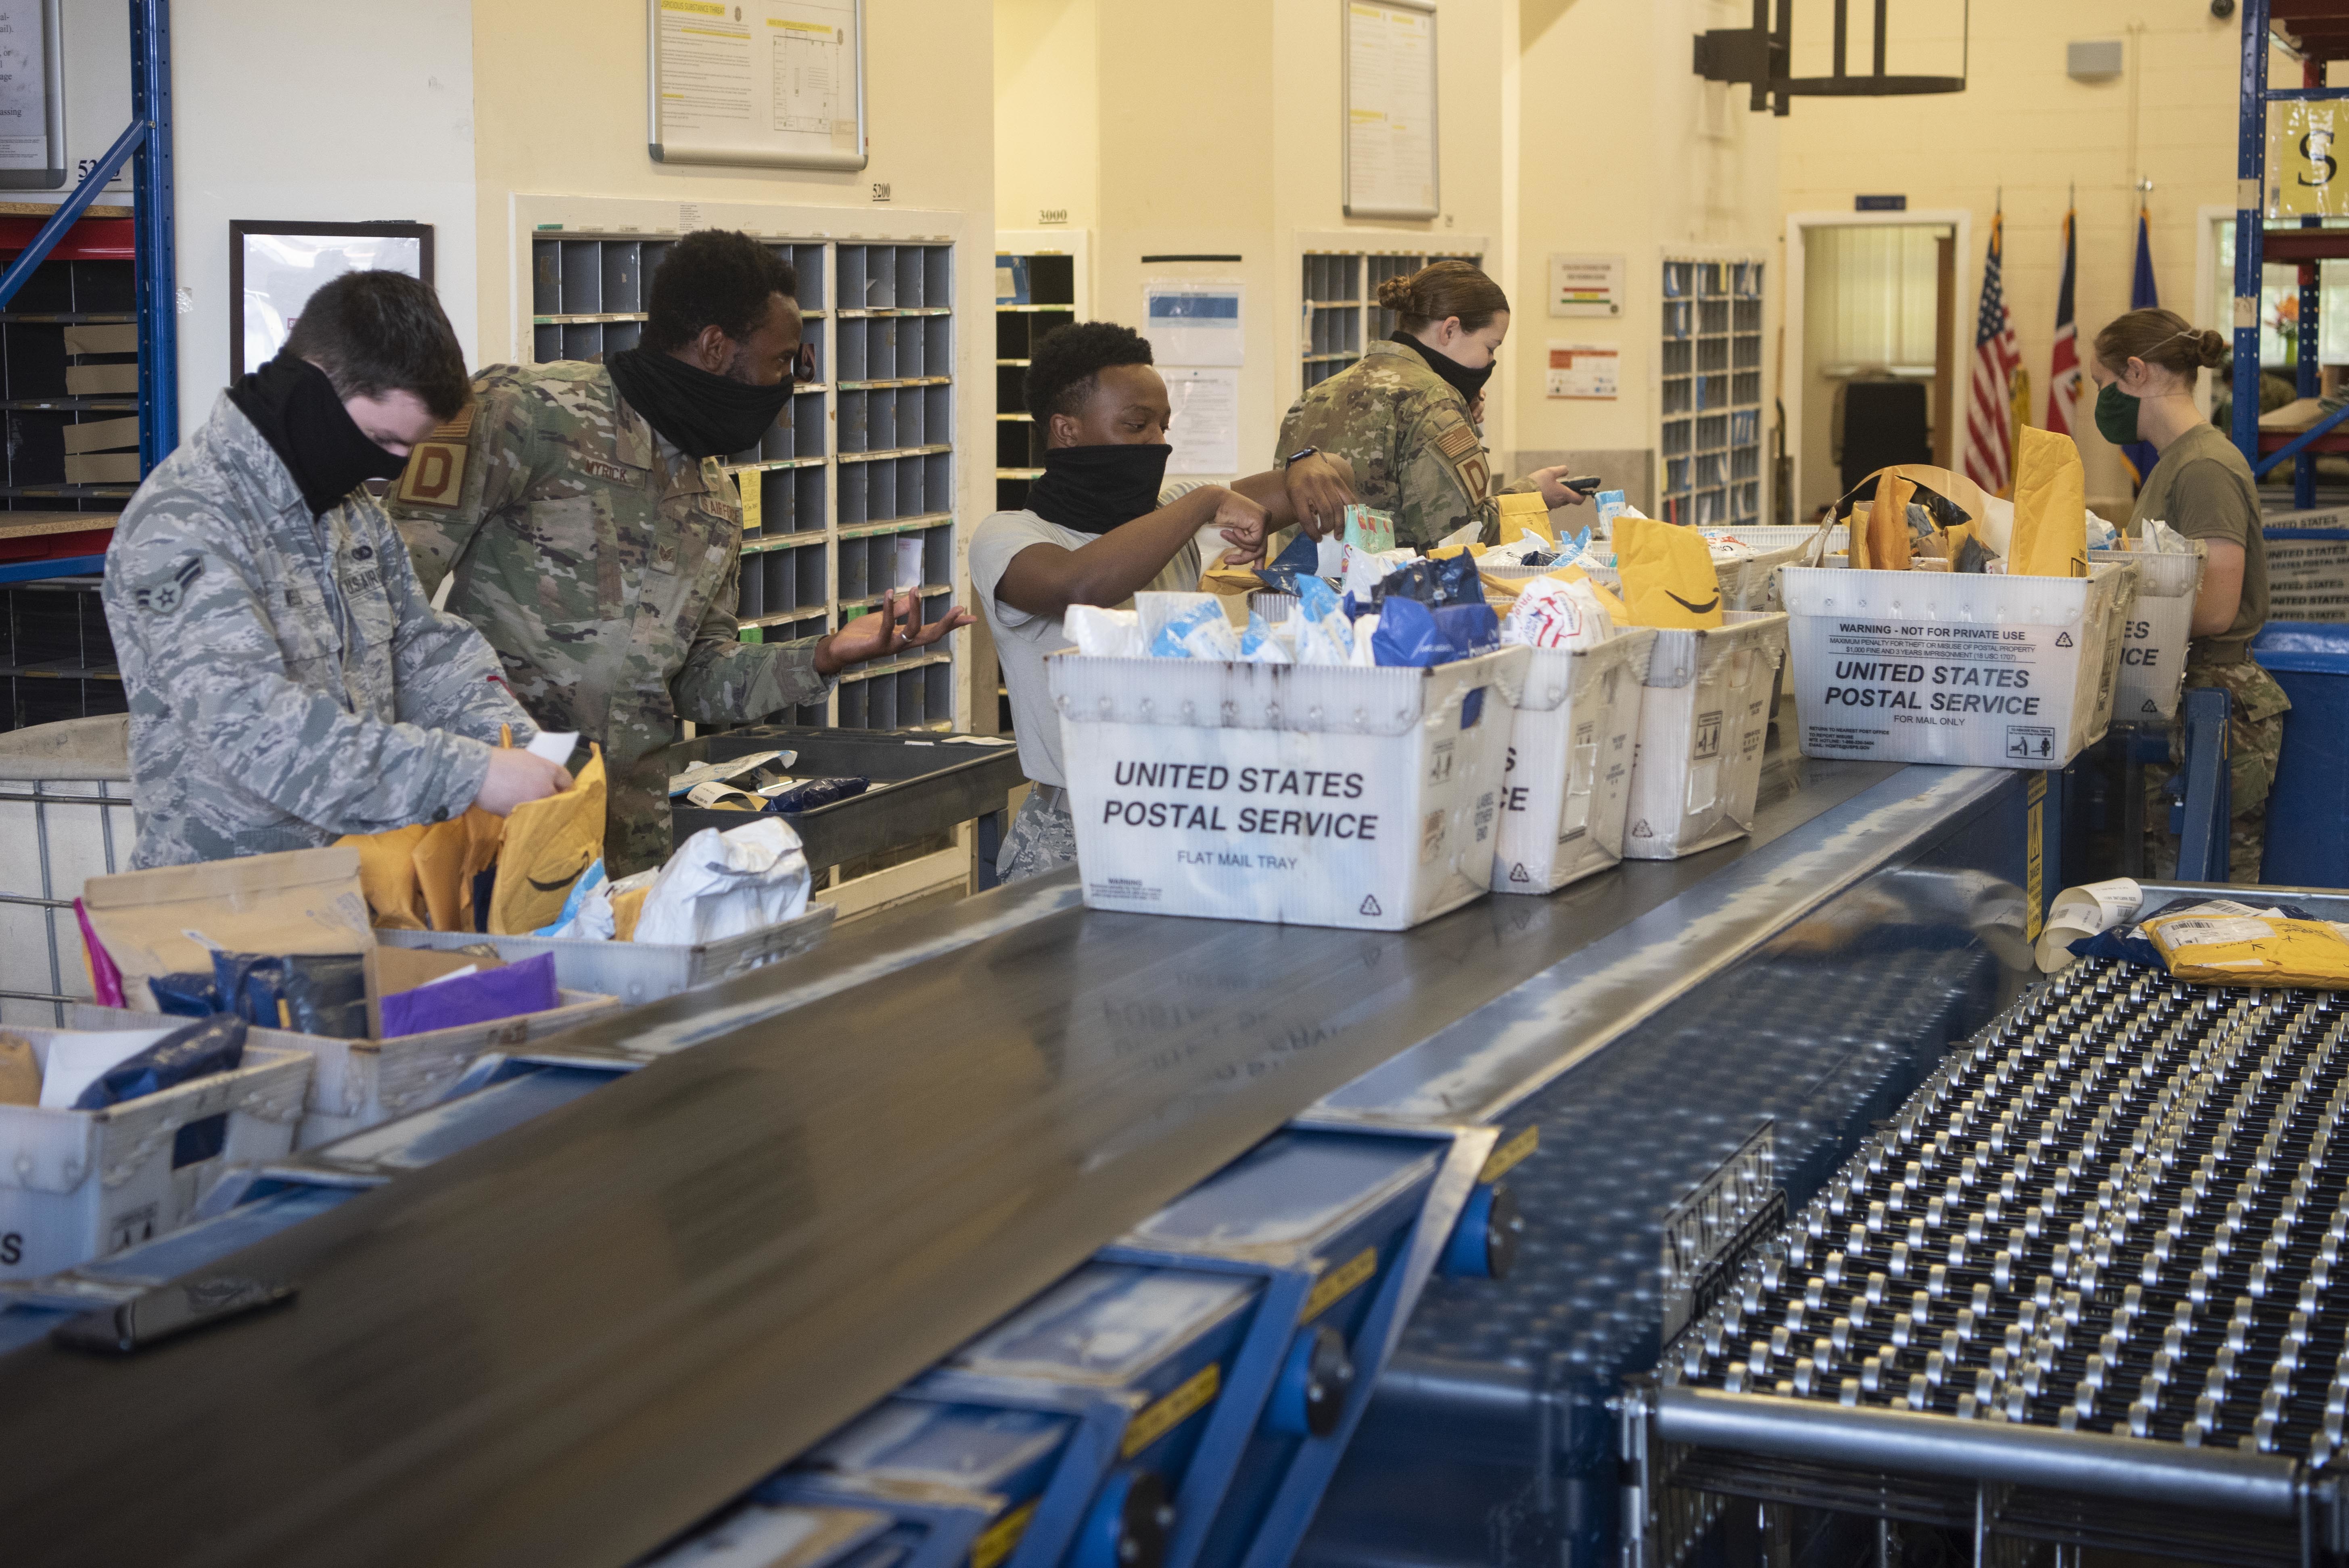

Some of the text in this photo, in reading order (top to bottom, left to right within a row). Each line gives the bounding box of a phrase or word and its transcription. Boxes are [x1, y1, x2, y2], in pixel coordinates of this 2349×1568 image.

[710, 6, 725, 14] THREAT
[0, 107, 22, 117] assing
[2297, 130, 2337, 187] S
[872, 184, 890, 199] 5200
[1039, 209, 1068, 222] 3000
[585, 459, 626, 482] MYRICK
[1840, 623, 1891, 634] WARNING
[1901, 626, 1924, 636] NOT
[1927, 628, 1950, 637] FOR
[1954, 629, 1999, 639] PRIVATE
[2003, 631, 2025, 640] USE
[1924, 650, 1973, 659] IMPRISONMENT
[1836, 661, 2030, 689] UNITED STATES
[1825, 687, 2040, 715] POSTAL SERVICE
[1894, 715, 1965, 726] FOR MAIL ONLY
[1115, 761, 1365, 799] UNITED STATES
[1103, 800, 1379, 840] POSTAL SERVICE
[1178, 850, 1298, 870] FLAT MAIL TRAY
[1, 1232, 23, 1265] S
